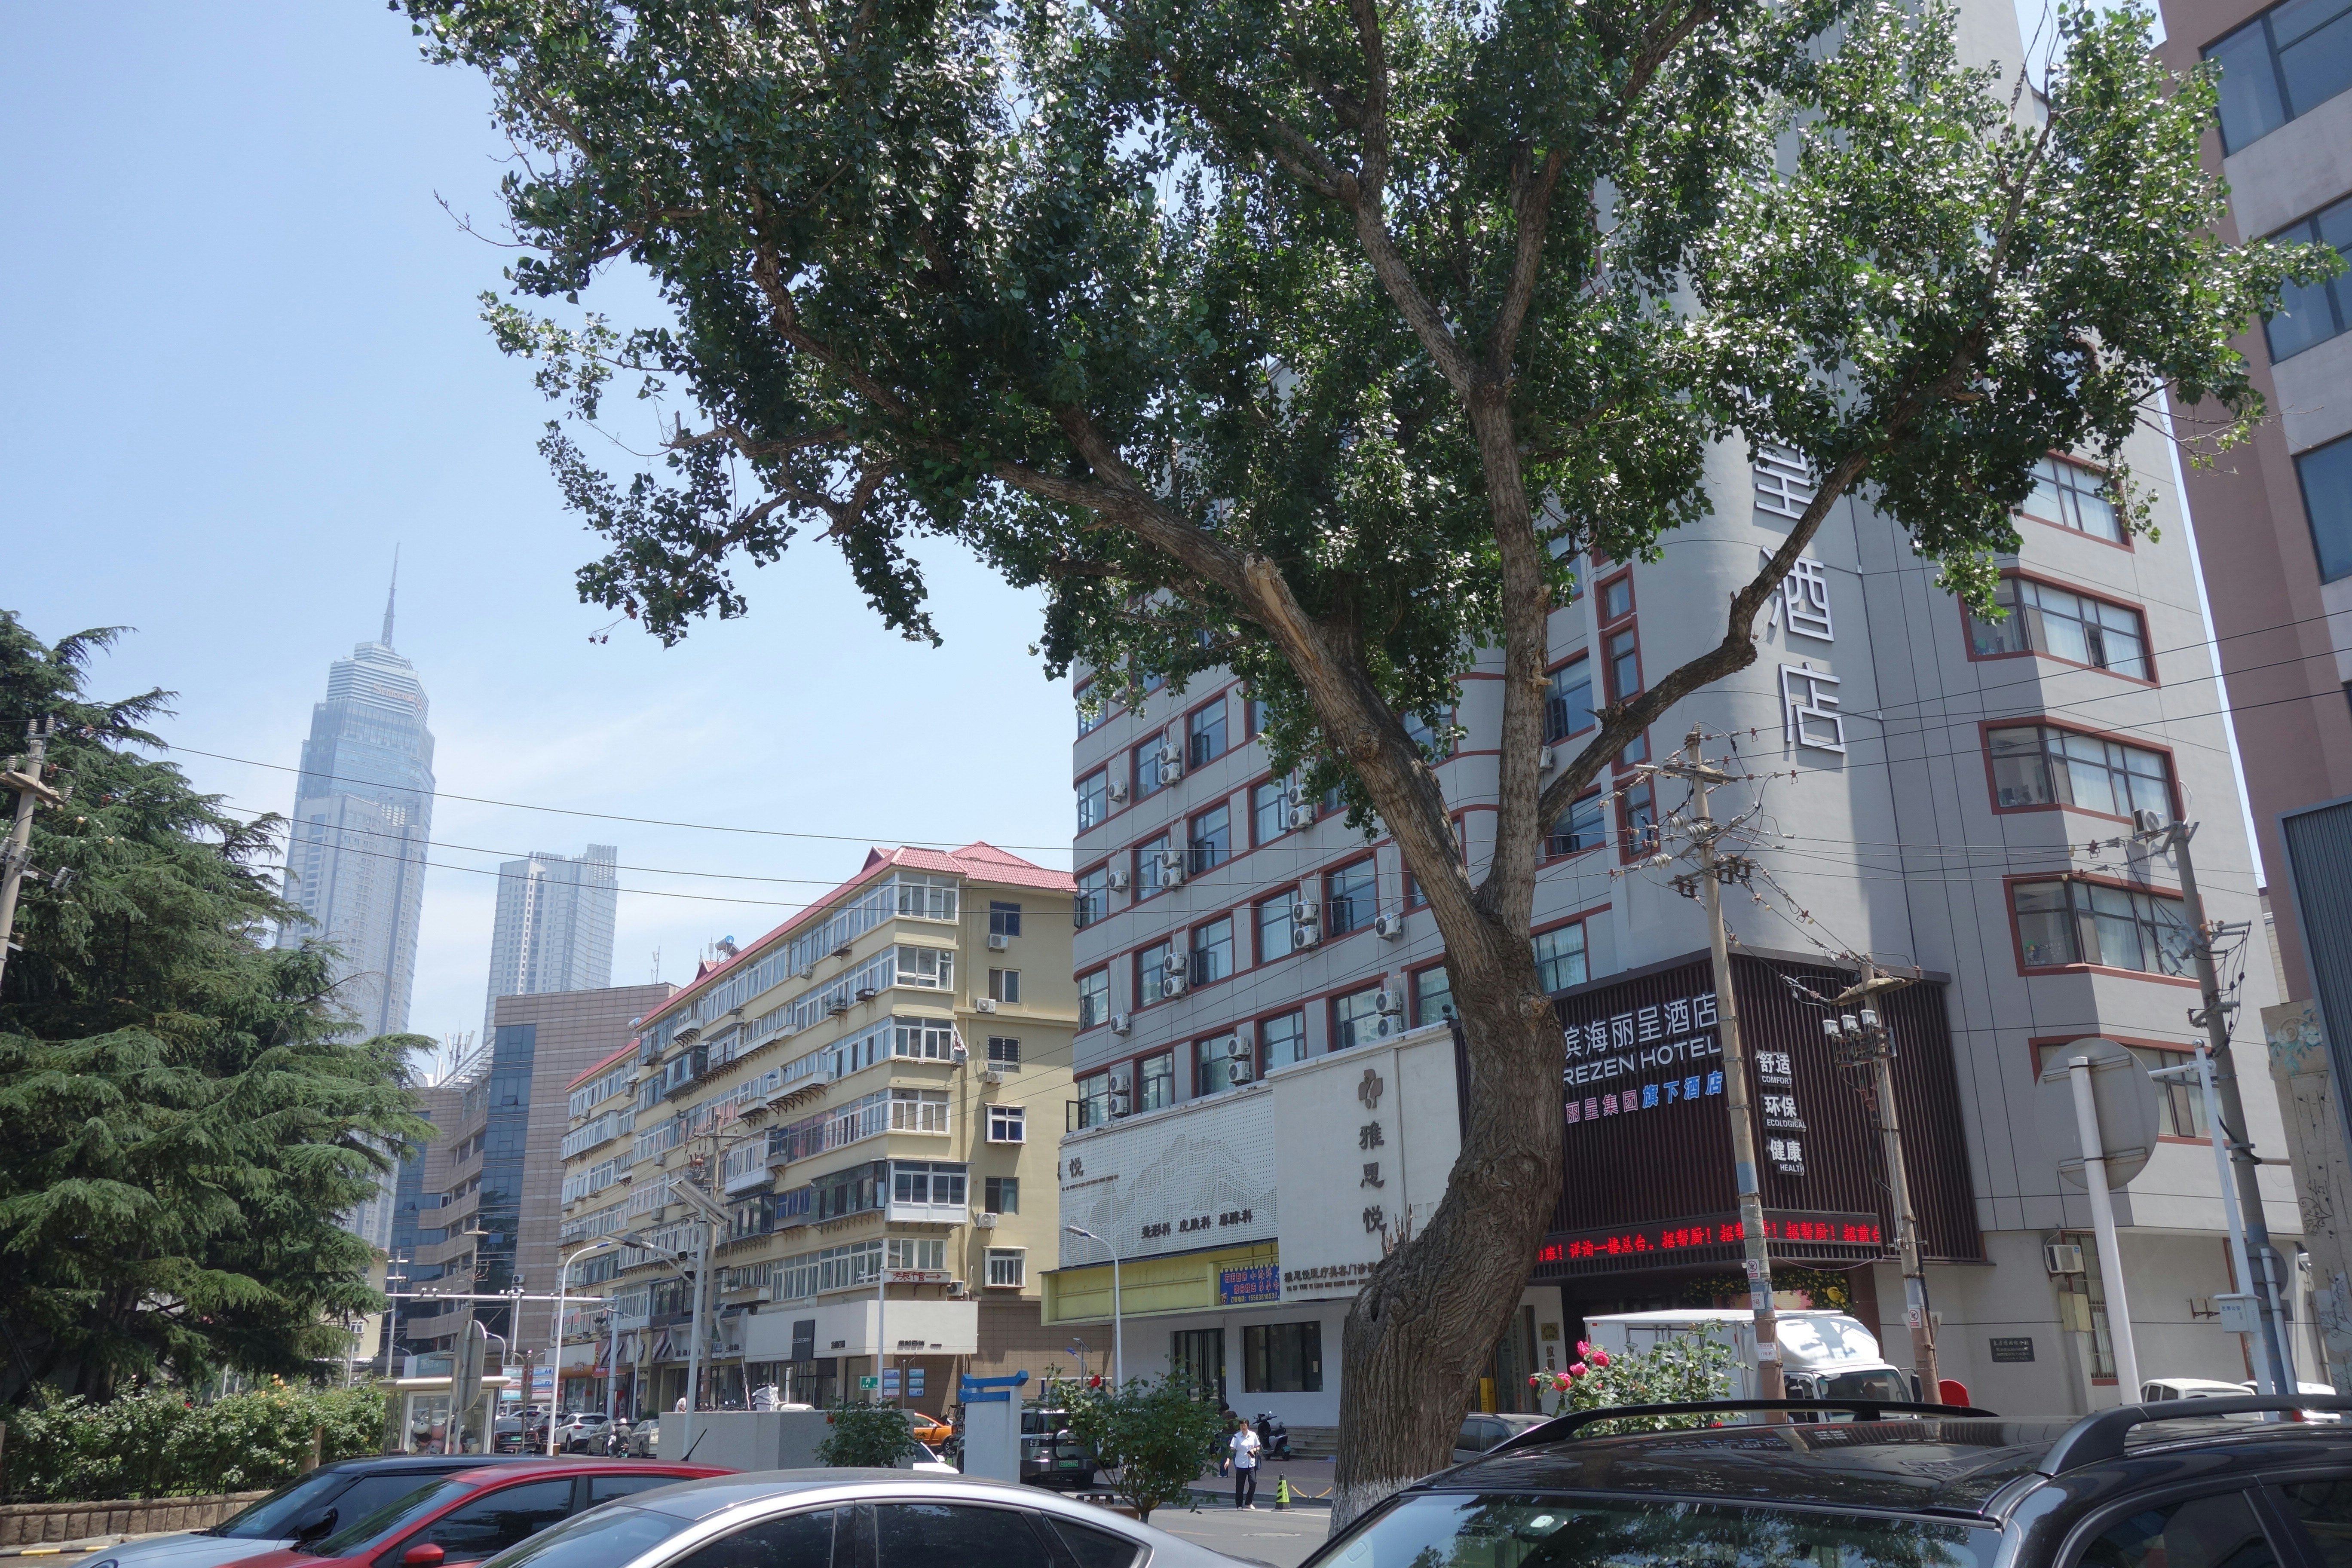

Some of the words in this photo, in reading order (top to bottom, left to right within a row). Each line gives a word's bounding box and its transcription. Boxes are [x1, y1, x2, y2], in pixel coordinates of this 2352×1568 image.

[1743, 385, 1846, 753] 呈酒店
[1564, 1054, 1635, 1087] REZEN
[1640, 1036, 1721, 1069] HOTEL
[1759, 1052, 1792, 1074] 舒适
[1761, 1075, 1792, 1085] COMFORT
[1565, 1070, 1723, 1124] 丽呈集团旗下酒店
[1764, 1096, 1797, 1118] 环保
[1767, 1118, 1807, 1129] ECOLOGICAL
[1770, 1139, 1802, 1162] 健康
[1358, 1121, 1387, 1233] 雅思悦
[1780, 1164, 1805, 1173] HEALTH
[1179, 1215, 1211, 1232] 皮肤科
[1219, 1208, 1253, 1226] 麻醉科
